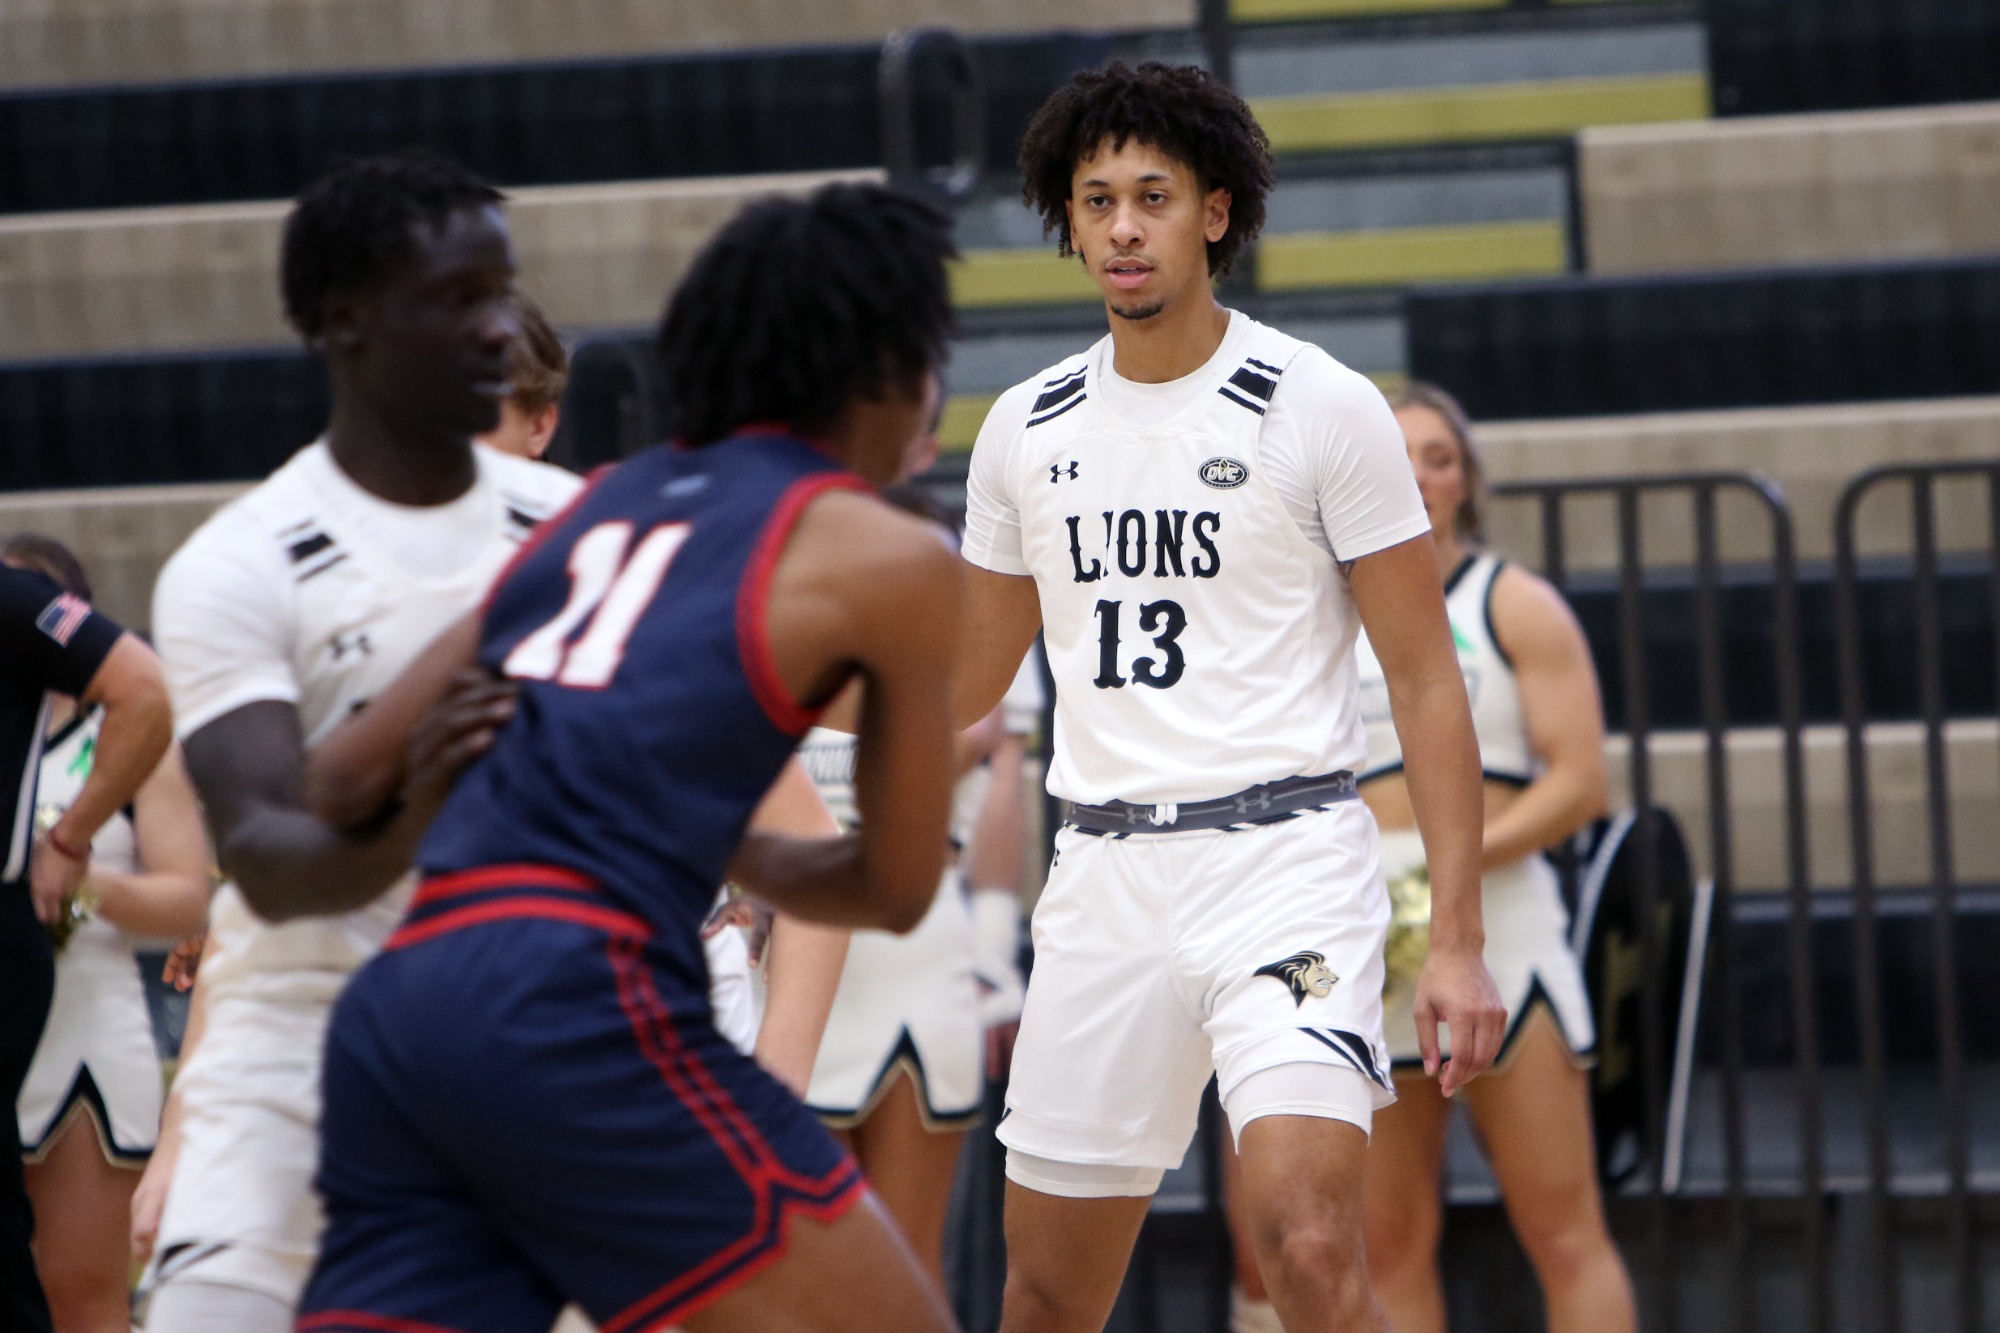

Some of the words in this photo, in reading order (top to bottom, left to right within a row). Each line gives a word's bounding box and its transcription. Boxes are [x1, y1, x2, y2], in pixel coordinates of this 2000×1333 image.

[1206, 465, 1239, 481] OVC
[1065, 508, 1221, 583] LIONS
[502, 519, 693, 690] 11
[1093, 599, 1188, 689] 13
